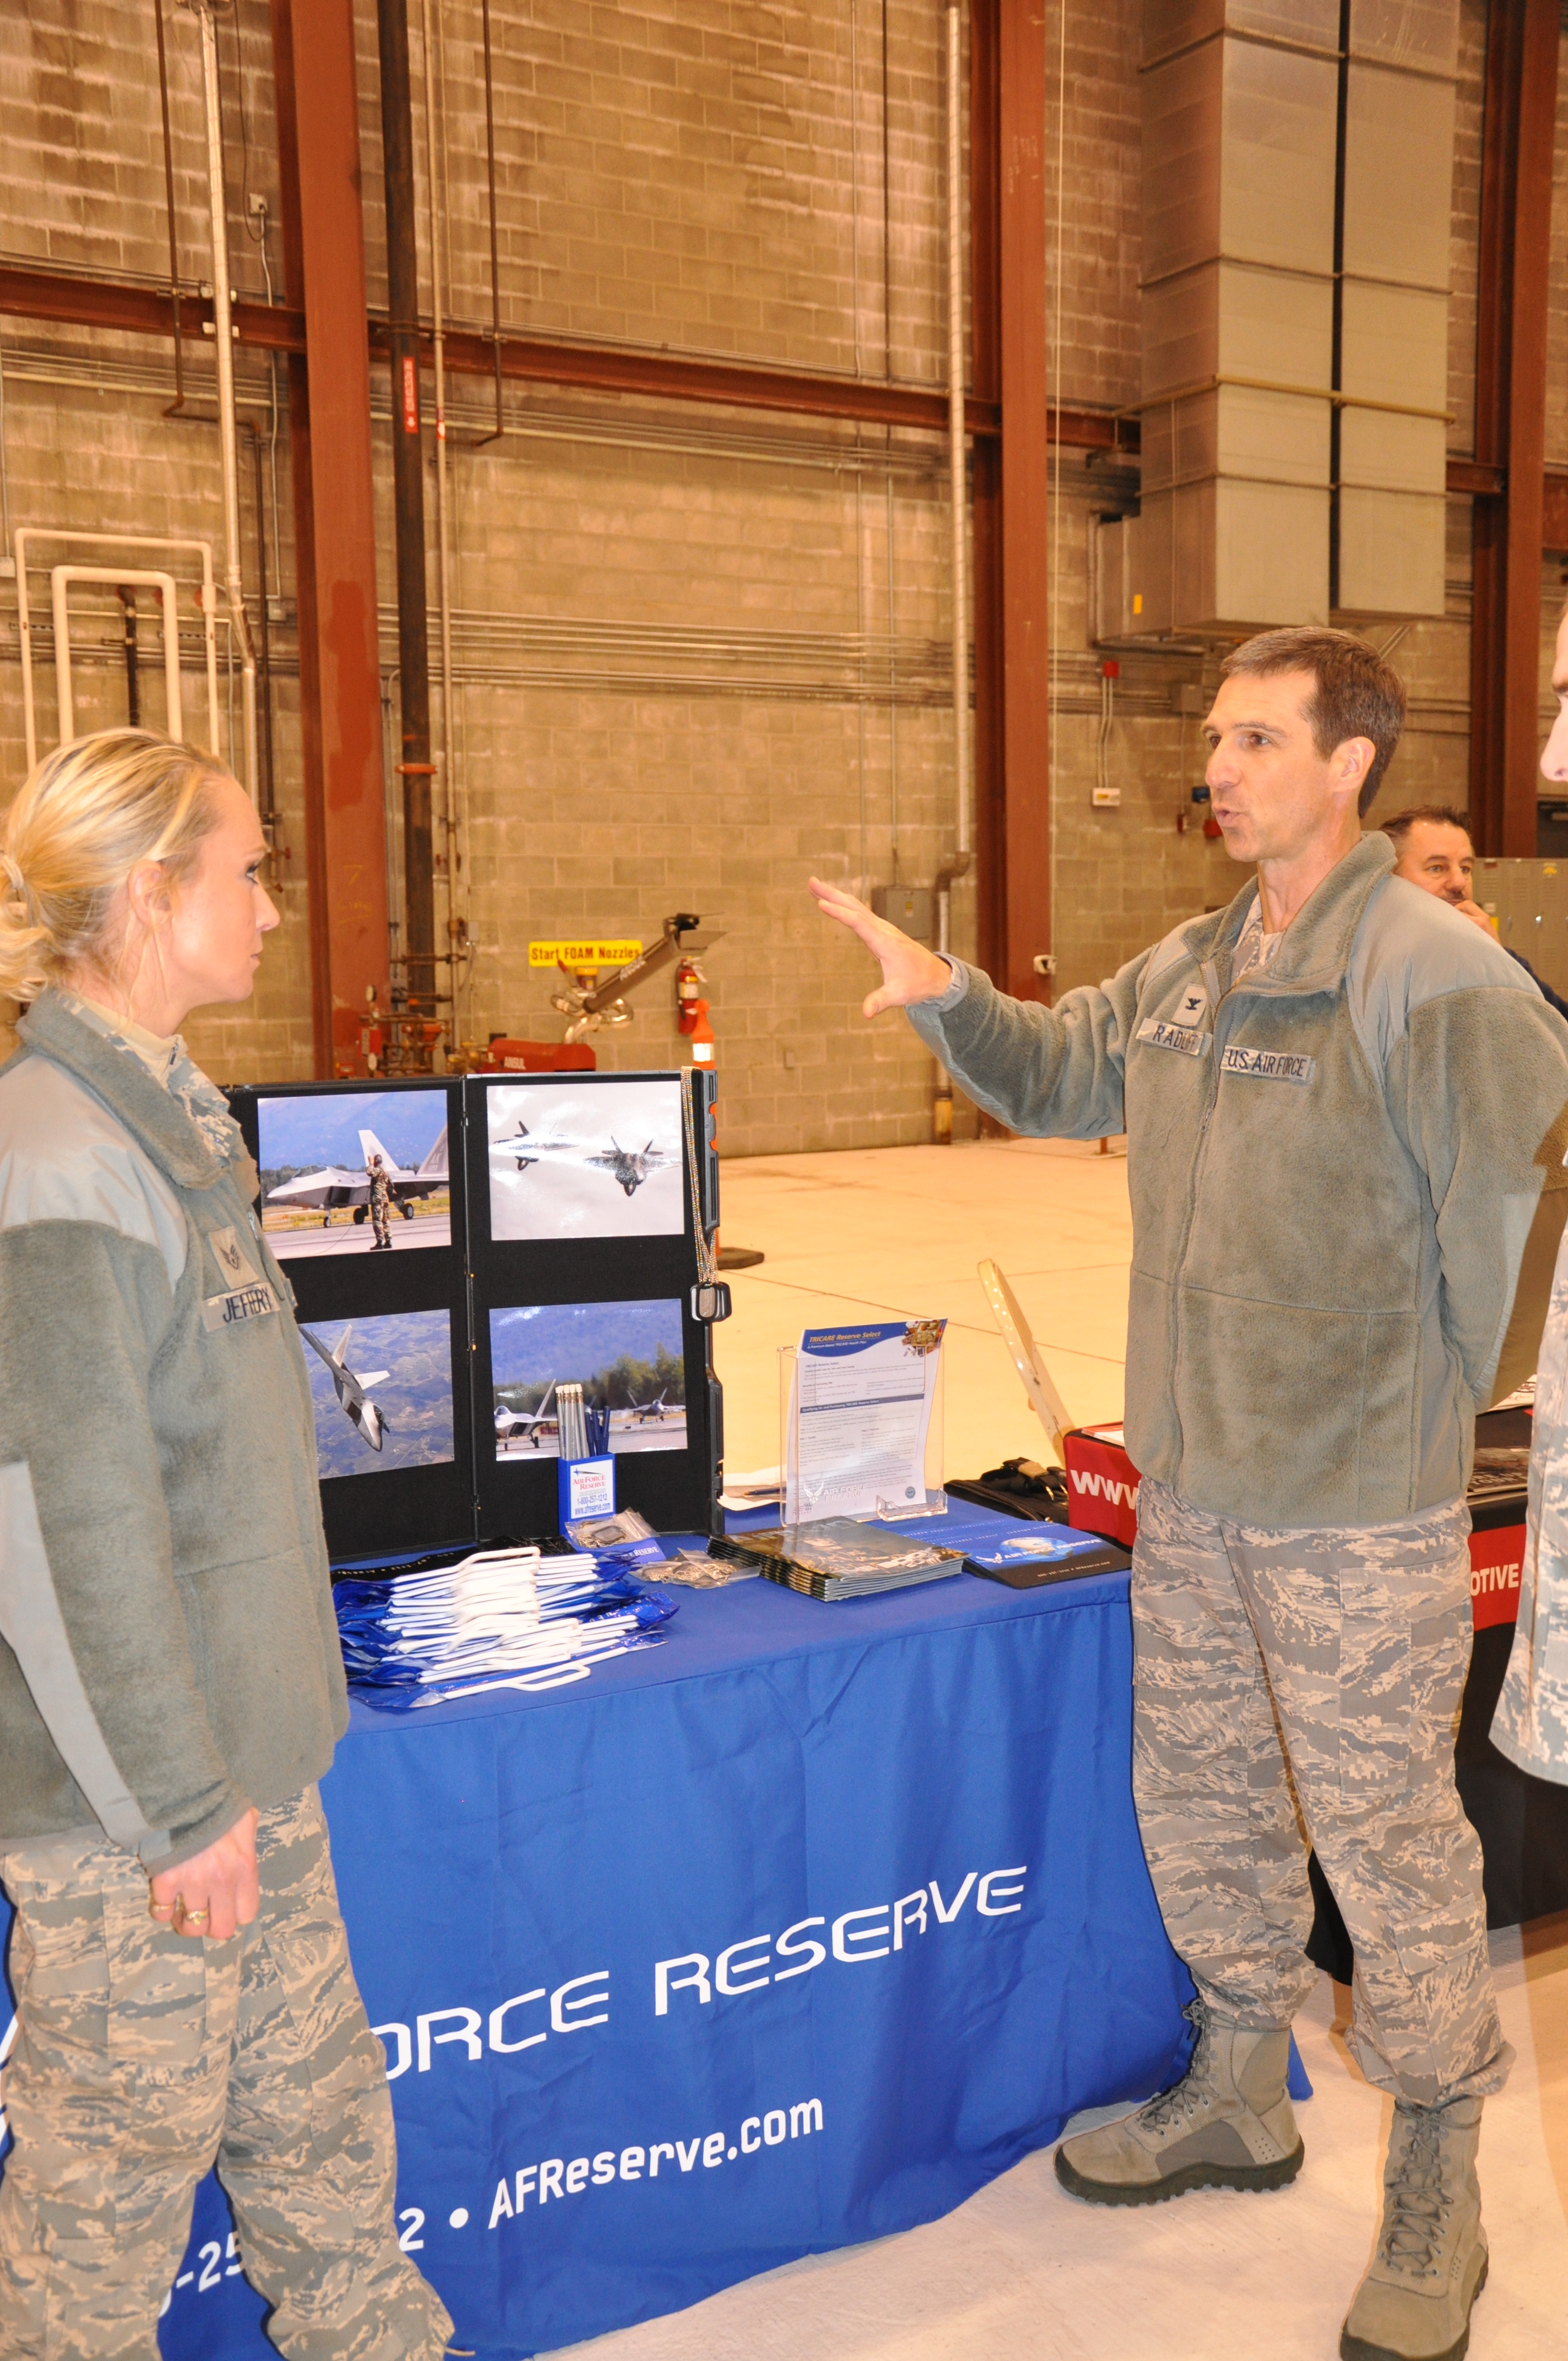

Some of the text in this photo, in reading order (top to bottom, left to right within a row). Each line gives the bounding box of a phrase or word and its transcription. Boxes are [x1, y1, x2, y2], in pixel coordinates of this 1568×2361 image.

[531, 947, 640, 960] Start FOAM Nozzles
[1228, 1049, 1307, 1077] U.S. AIR FORCE
[580, 1481, 606, 1489] RESERVE
[840, 1484, 866, 1493] FORCE
[825, 1492, 865, 1502] RESERVE
[1056, 1539, 1102, 1549] RESERVE
[633, 1546, 660, 1557] RESERVE
[655, 1865, 1027, 2016] RESERVE
[488, 2098, 824, 2229] AFReserve.com
